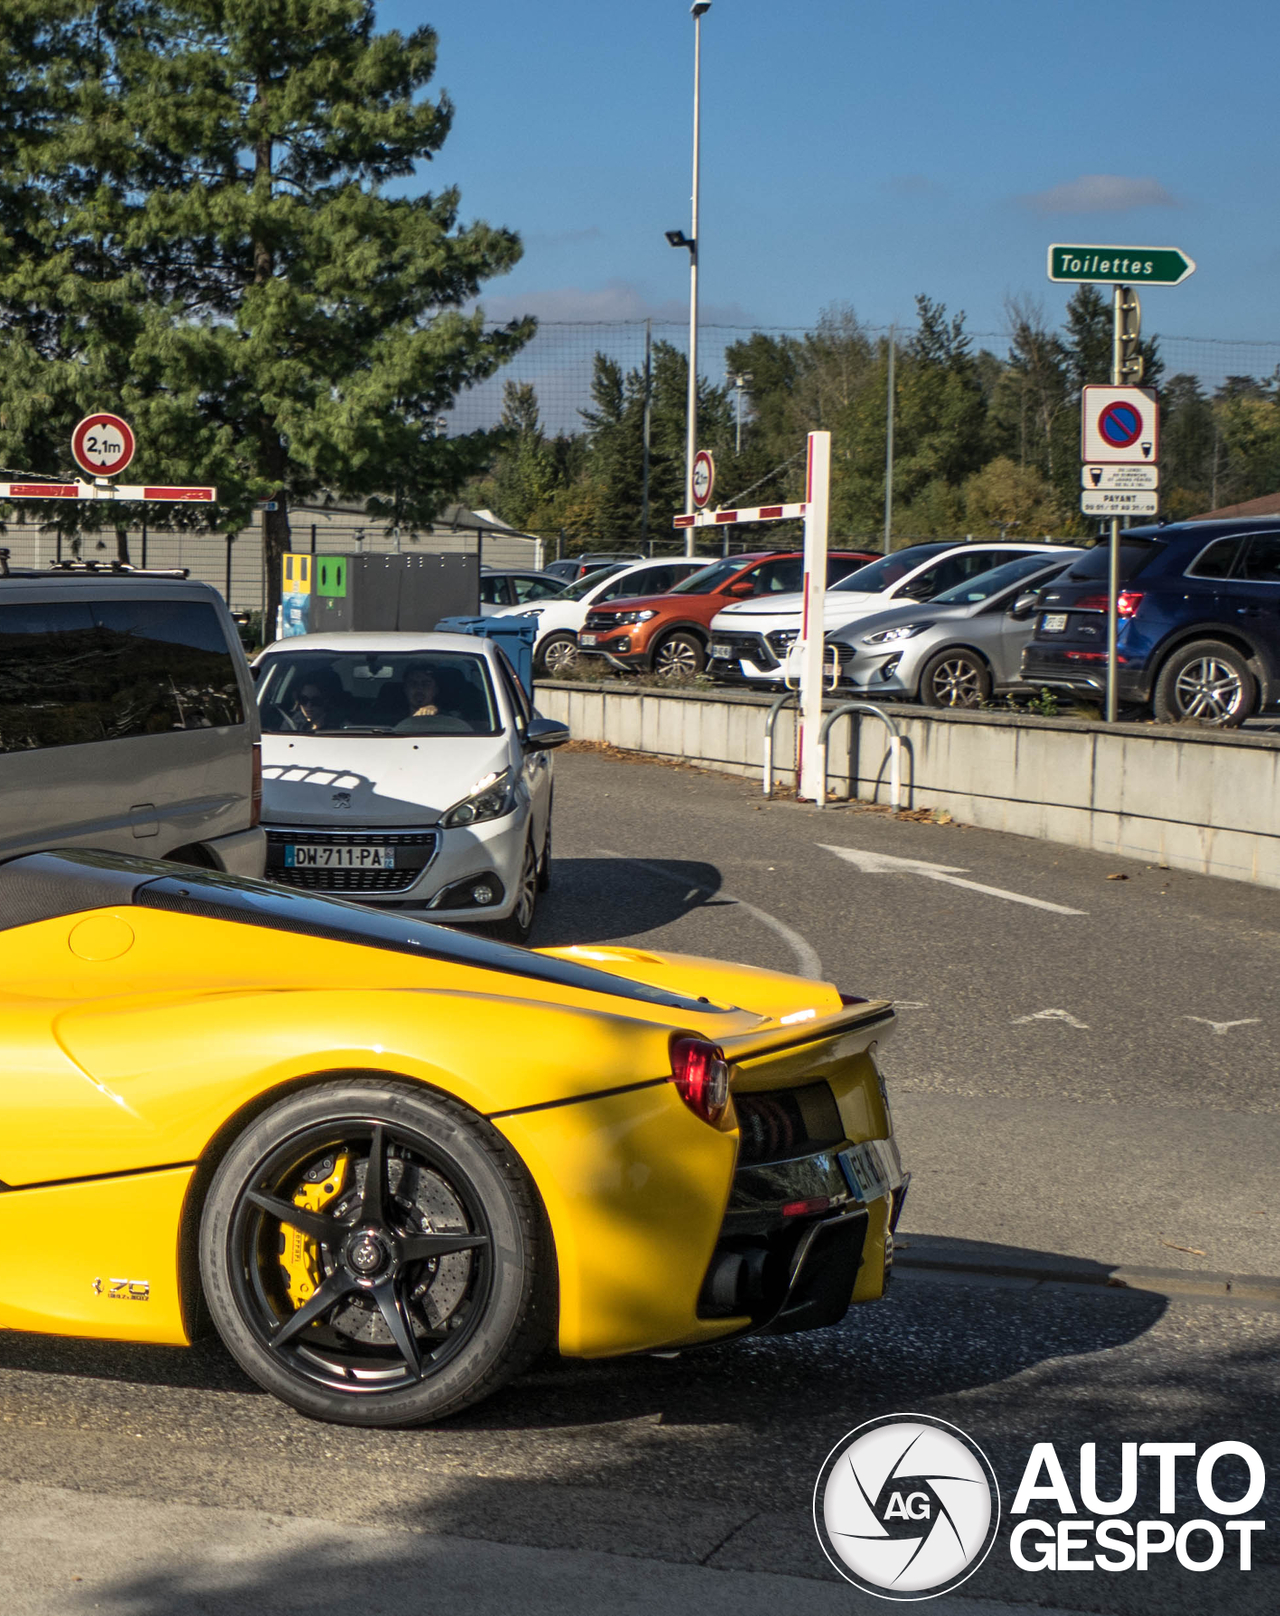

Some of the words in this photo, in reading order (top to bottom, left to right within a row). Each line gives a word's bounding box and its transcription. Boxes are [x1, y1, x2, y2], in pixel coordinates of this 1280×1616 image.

[1061, 254, 1153, 274] Toilettes
[87, 436, 121, 455] 2,1m
[296, 848, 382, 866] DW-711-PA
